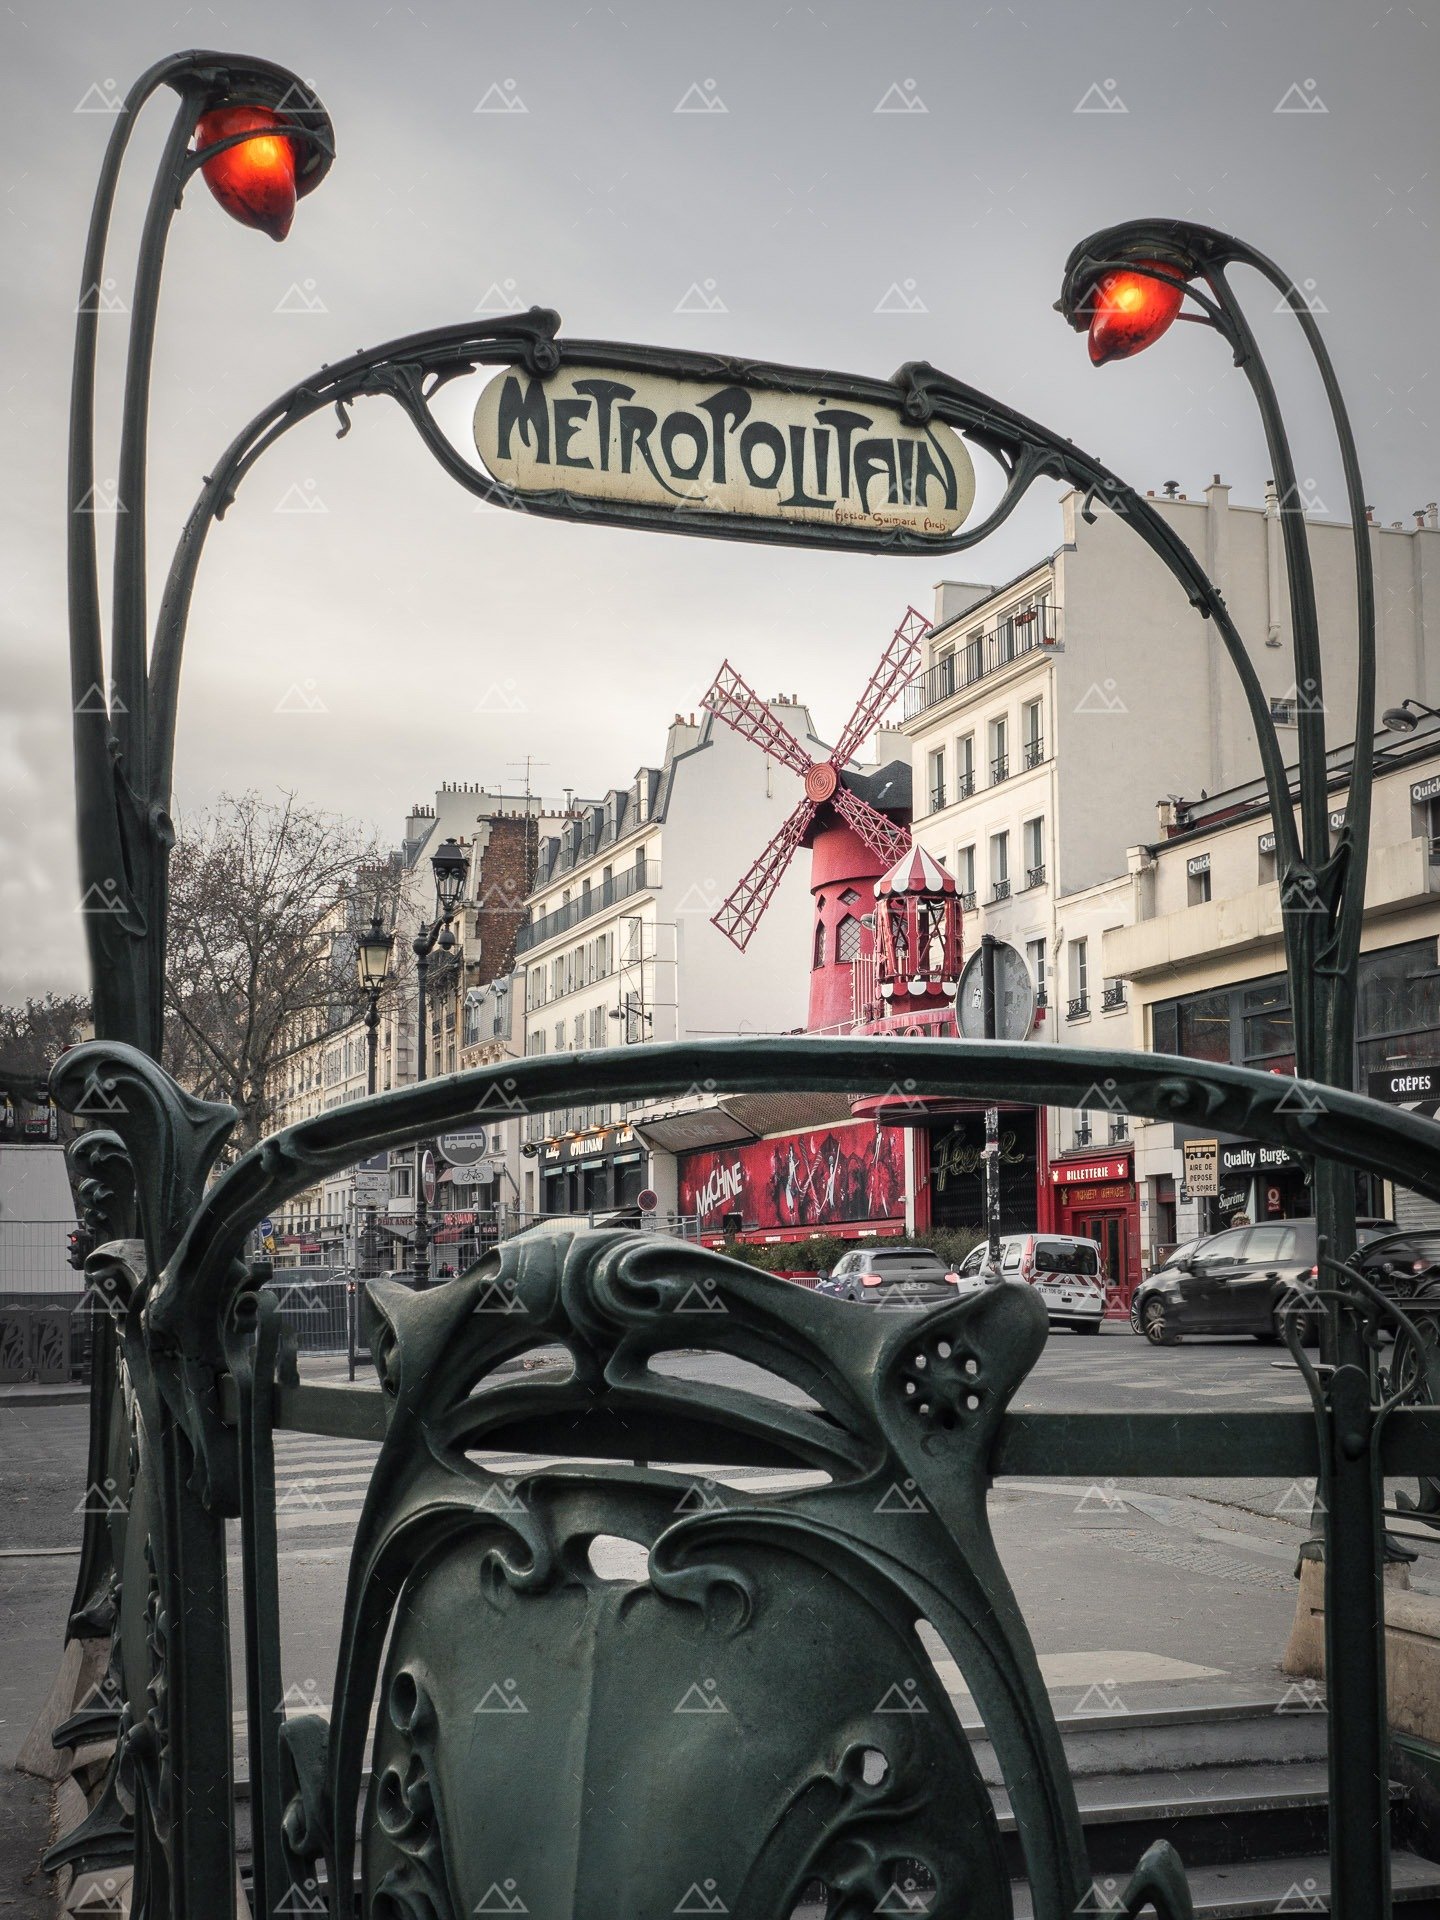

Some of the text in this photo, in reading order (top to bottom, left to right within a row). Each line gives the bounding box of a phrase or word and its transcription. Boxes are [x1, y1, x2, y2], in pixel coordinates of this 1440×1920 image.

[497, 376, 958, 514] METROPOLITAIN
[1260, 834, 1276, 850] Qui
[1390, 1075, 1432, 1093] CRÊPES
[1223, 1148, 1290, 1168] Quality Burge
[1066, 1166, 1109, 1181] BILLETTERIE
[696, 1161, 743, 1217] MACHINE
